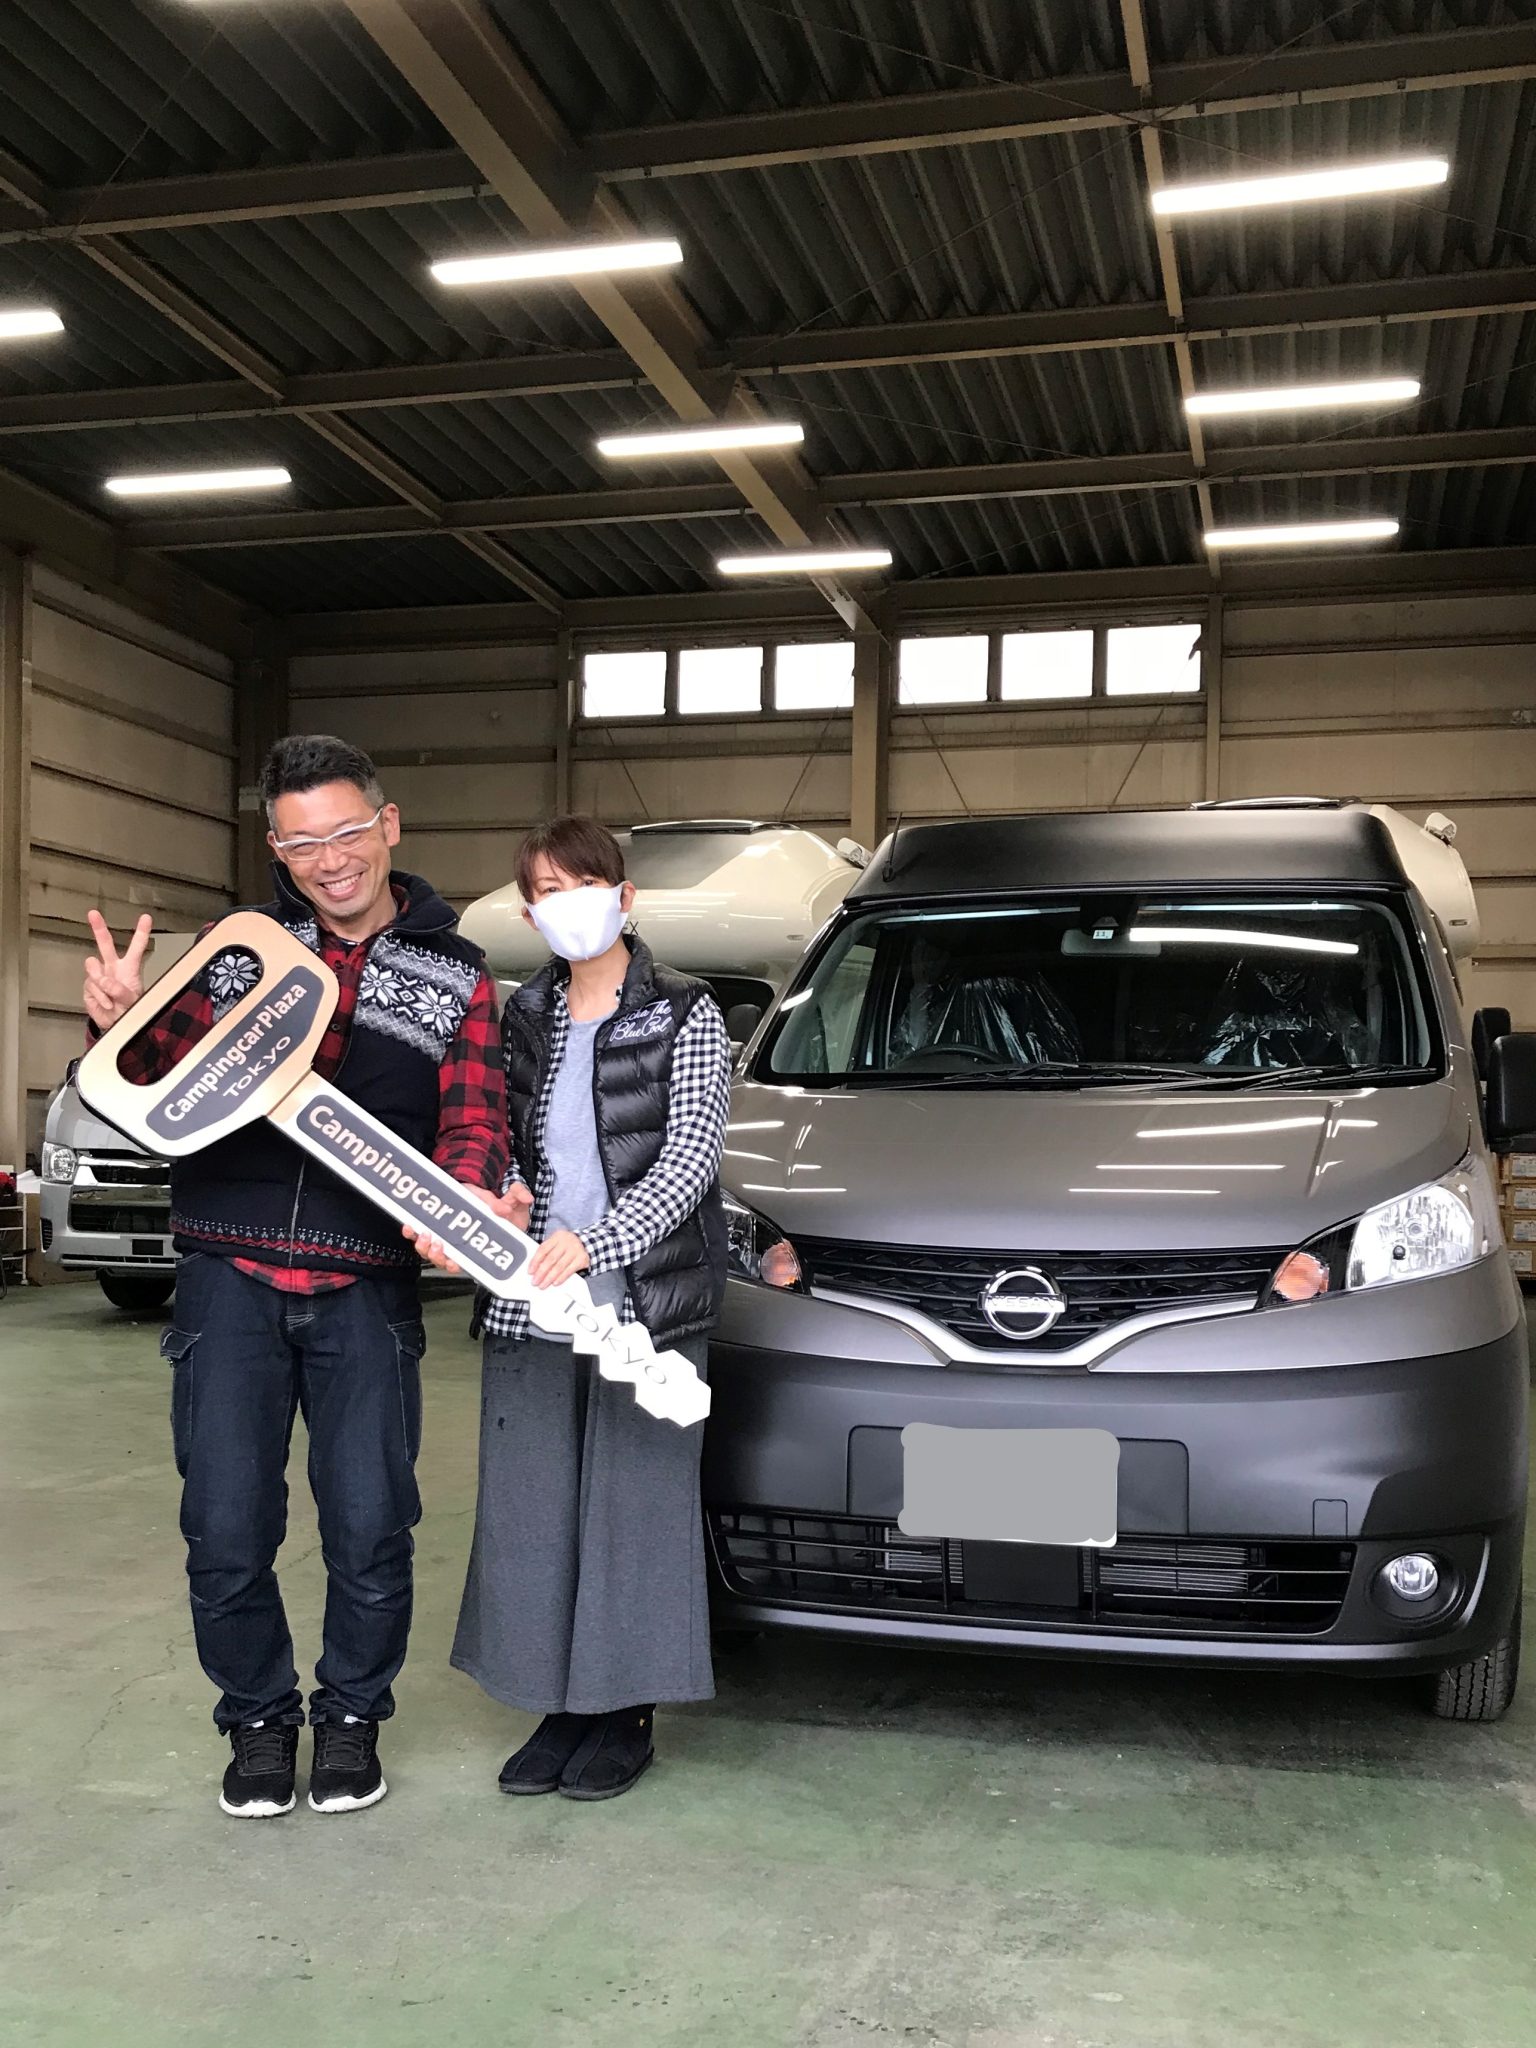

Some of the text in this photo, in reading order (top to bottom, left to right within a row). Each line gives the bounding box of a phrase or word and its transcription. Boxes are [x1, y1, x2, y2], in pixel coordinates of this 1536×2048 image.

[164, 984, 307, 1122] Campingcar Plaza
[609, 1021, 642, 1042] Blue
[309, 1105, 514, 1271] Campingcar Plaza
